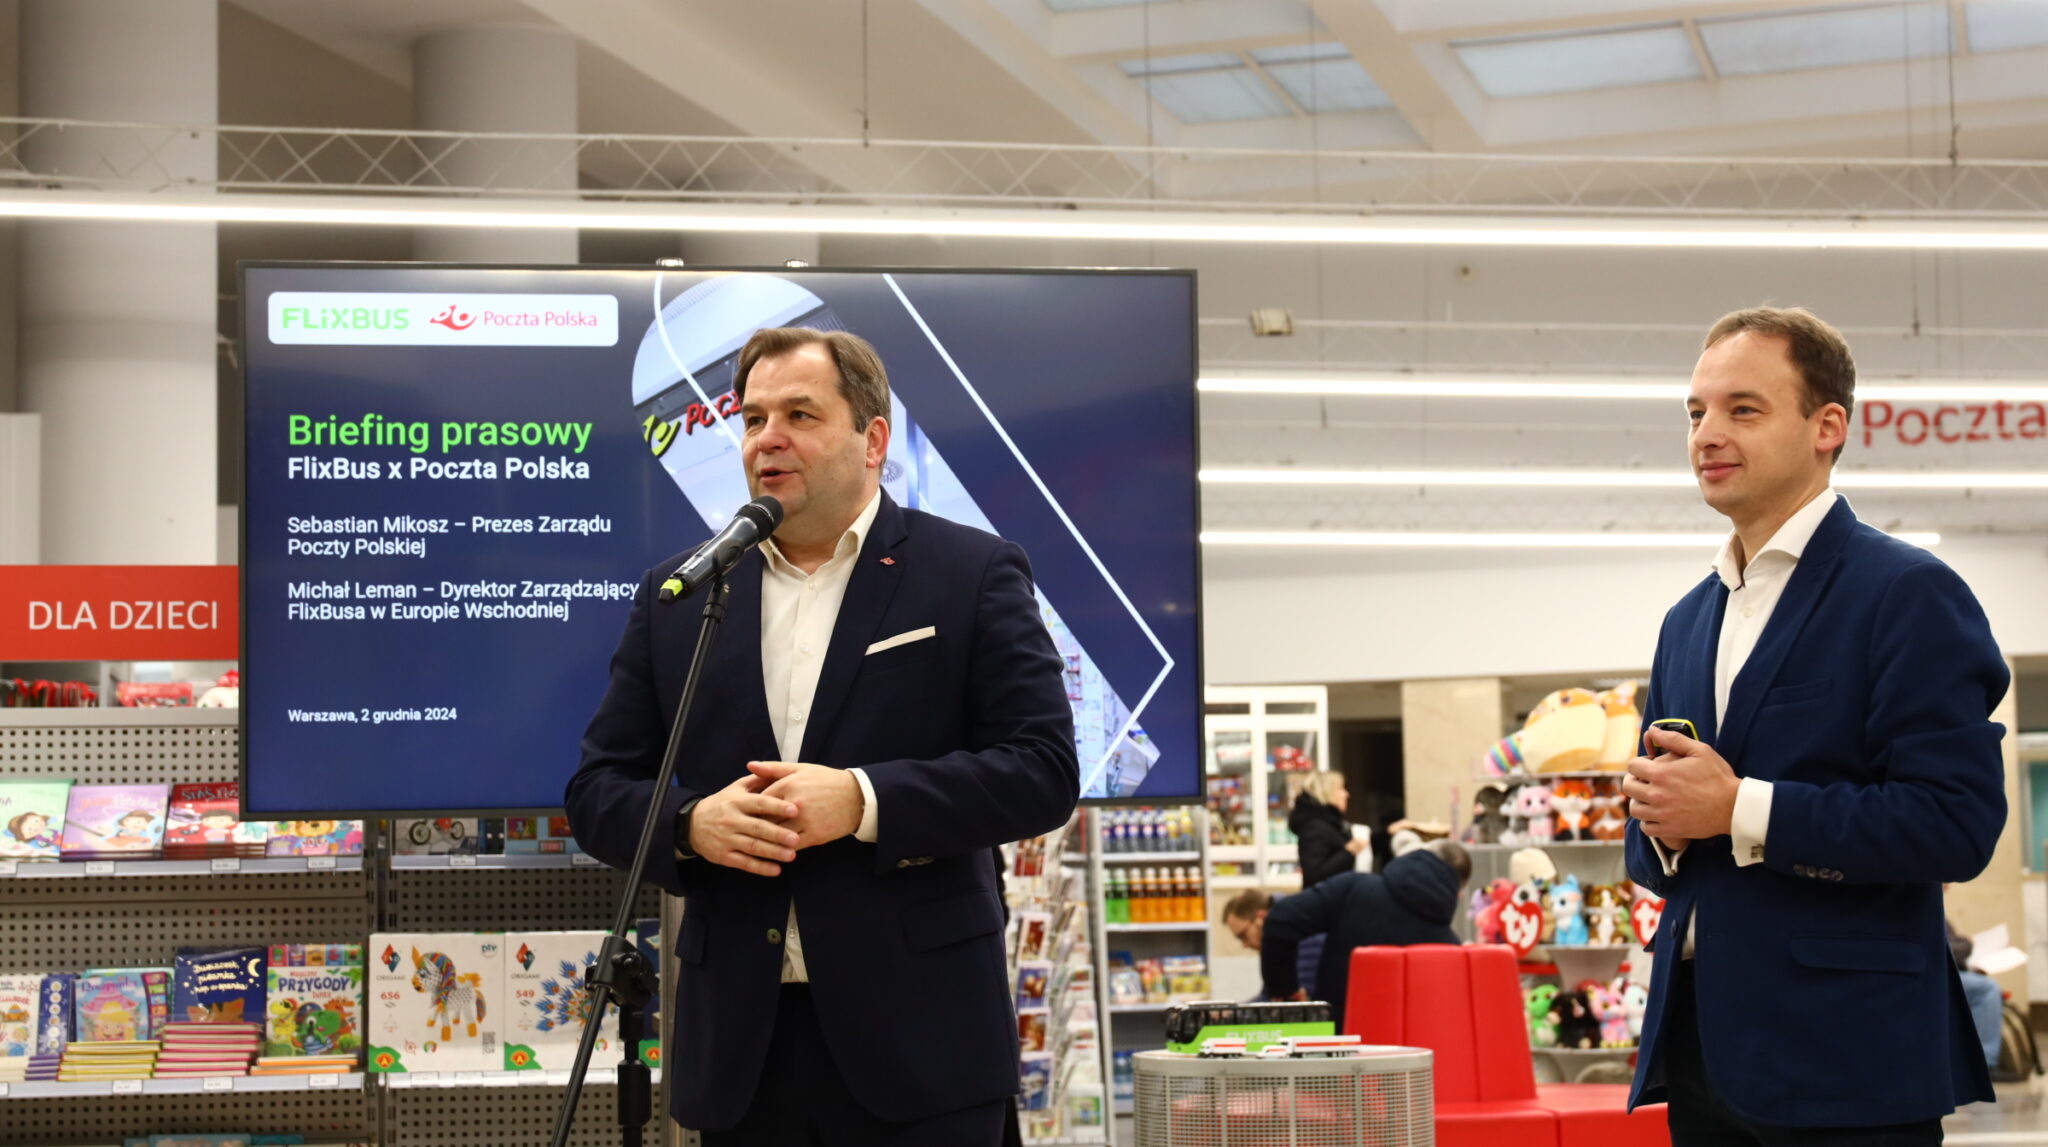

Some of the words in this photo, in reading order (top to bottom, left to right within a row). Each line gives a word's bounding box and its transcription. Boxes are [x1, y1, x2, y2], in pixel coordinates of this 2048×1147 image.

[483, 310, 540, 327] Poczta
[545, 310, 598, 327] Polska
[288, 412, 431, 453] Briefing
[441, 421, 593, 453] prasowy
[1861, 400, 2048, 448] Poczta
[288, 456, 381, 479] FlixBus
[388, 462, 403, 479] x
[410, 457, 497, 479] Poczta
[505, 456, 590, 479] Polska
[287, 515, 379, 534] Sebastian
[383, 515, 449, 533] Mikosz
[472, 516, 534, 533] Prezes
[538, 515, 612, 536] Zarządu
[288, 538, 350, 558] Poczty
[355, 537, 426, 558] Polskiej
[288, 580, 350, 599] Michał
[355, 582, 417, 599] Leman
[440, 580, 517, 601] Dyrektor
[521, 579, 640, 601] Zarządzający
[28, 601, 98, 630] DLA
[109, 601, 219, 630] DZIECI
[288, 602, 366, 620] FlixBusa
[370, 606, 386, 619] w
[391, 602, 460, 622] Europie
[464, 600, 570, 622] Wschodniej
[288, 709, 359, 724] Warszawa,
[361, 708, 370, 721] 2
[373, 708, 422, 724] grudnia
[424, 707, 458, 721] 2024
[1499, 903, 1539, 949] ty
[278, 977, 350, 993] PRZYGODY
[380, 991, 401, 1000] 656
[515, 989, 536, 999] 549
